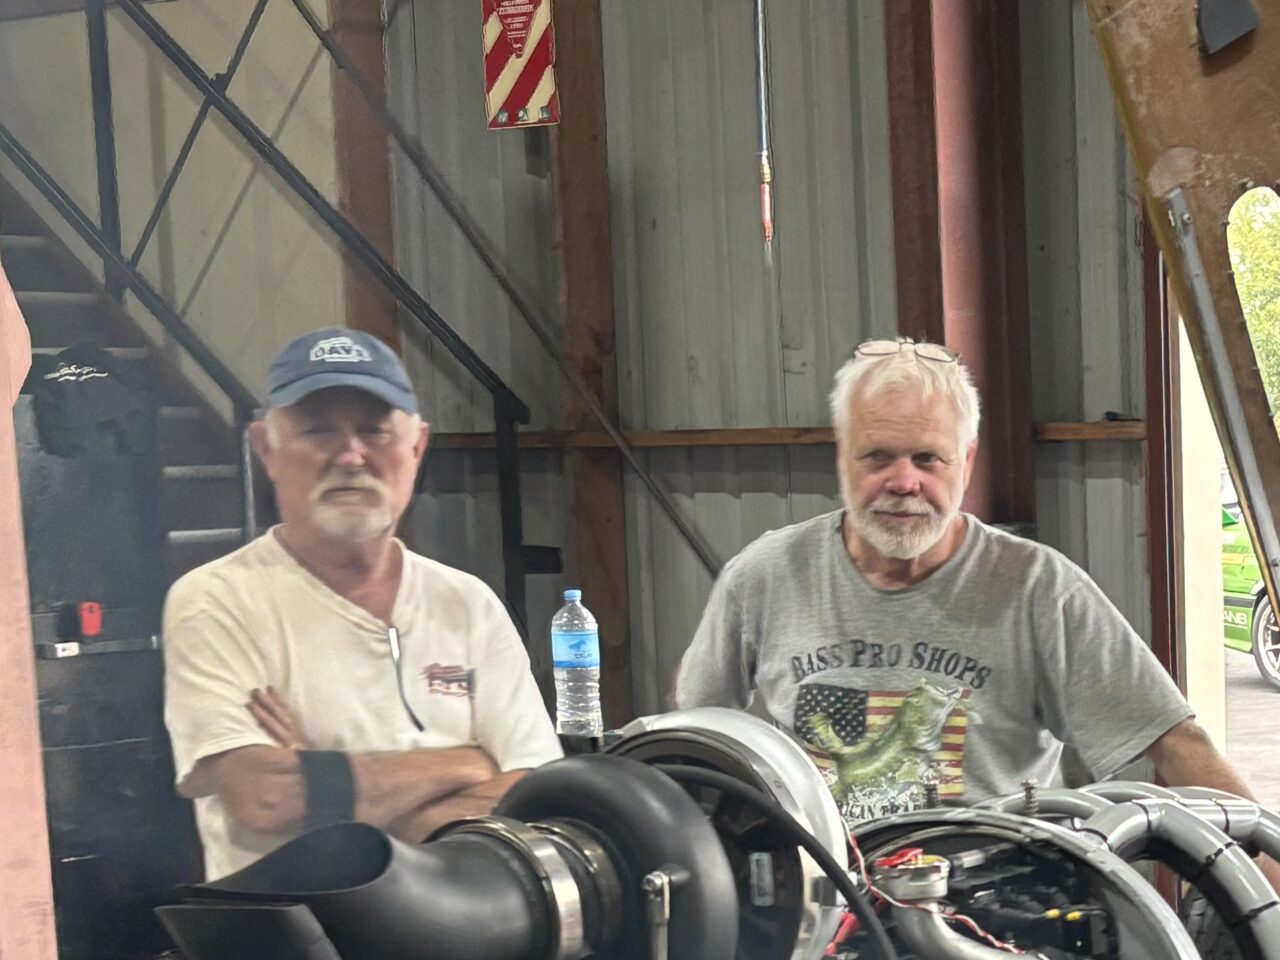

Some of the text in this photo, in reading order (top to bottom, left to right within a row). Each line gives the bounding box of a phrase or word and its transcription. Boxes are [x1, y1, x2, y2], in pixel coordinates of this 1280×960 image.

[791, 639, 992, 690] BASS PRO SHOPS
